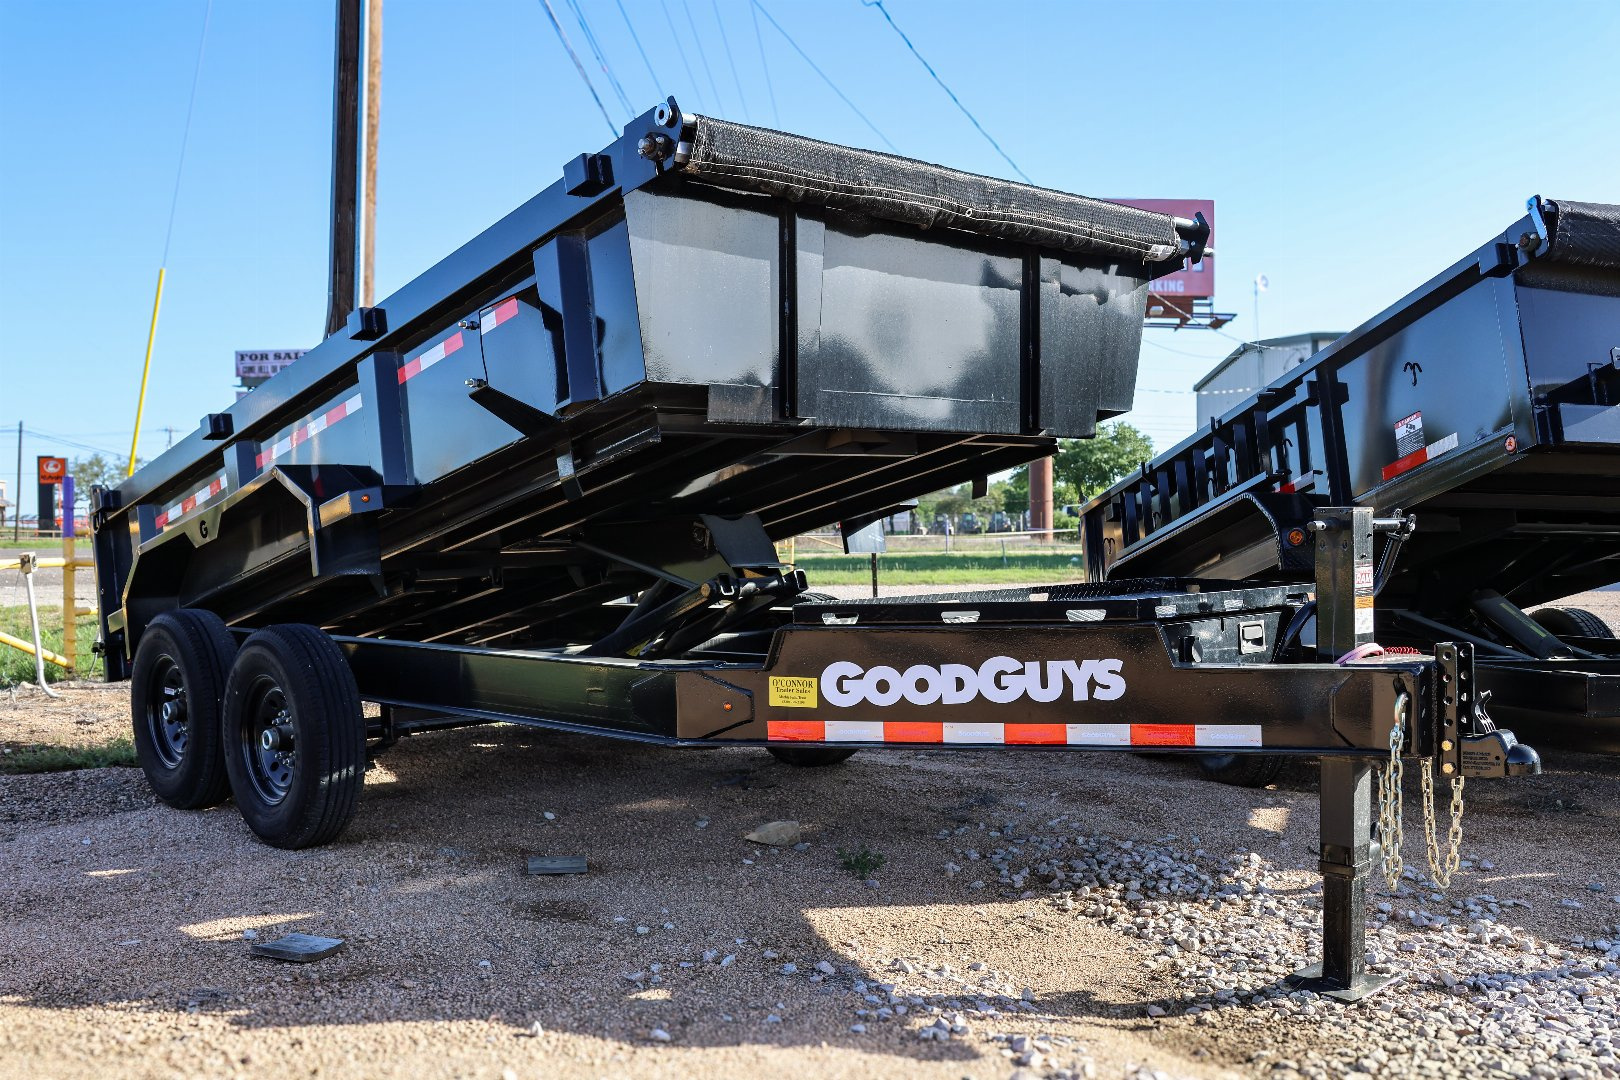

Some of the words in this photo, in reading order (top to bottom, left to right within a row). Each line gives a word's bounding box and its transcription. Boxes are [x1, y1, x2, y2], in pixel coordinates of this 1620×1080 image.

[240, 353, 269, 361] FOR
[273, 352, 307, 360] SAL
[199, 520, 208, 539] G
[772, 678, 813, 689] O'CONNOR
[820, 656, 1127, 708] GOODGUYS
